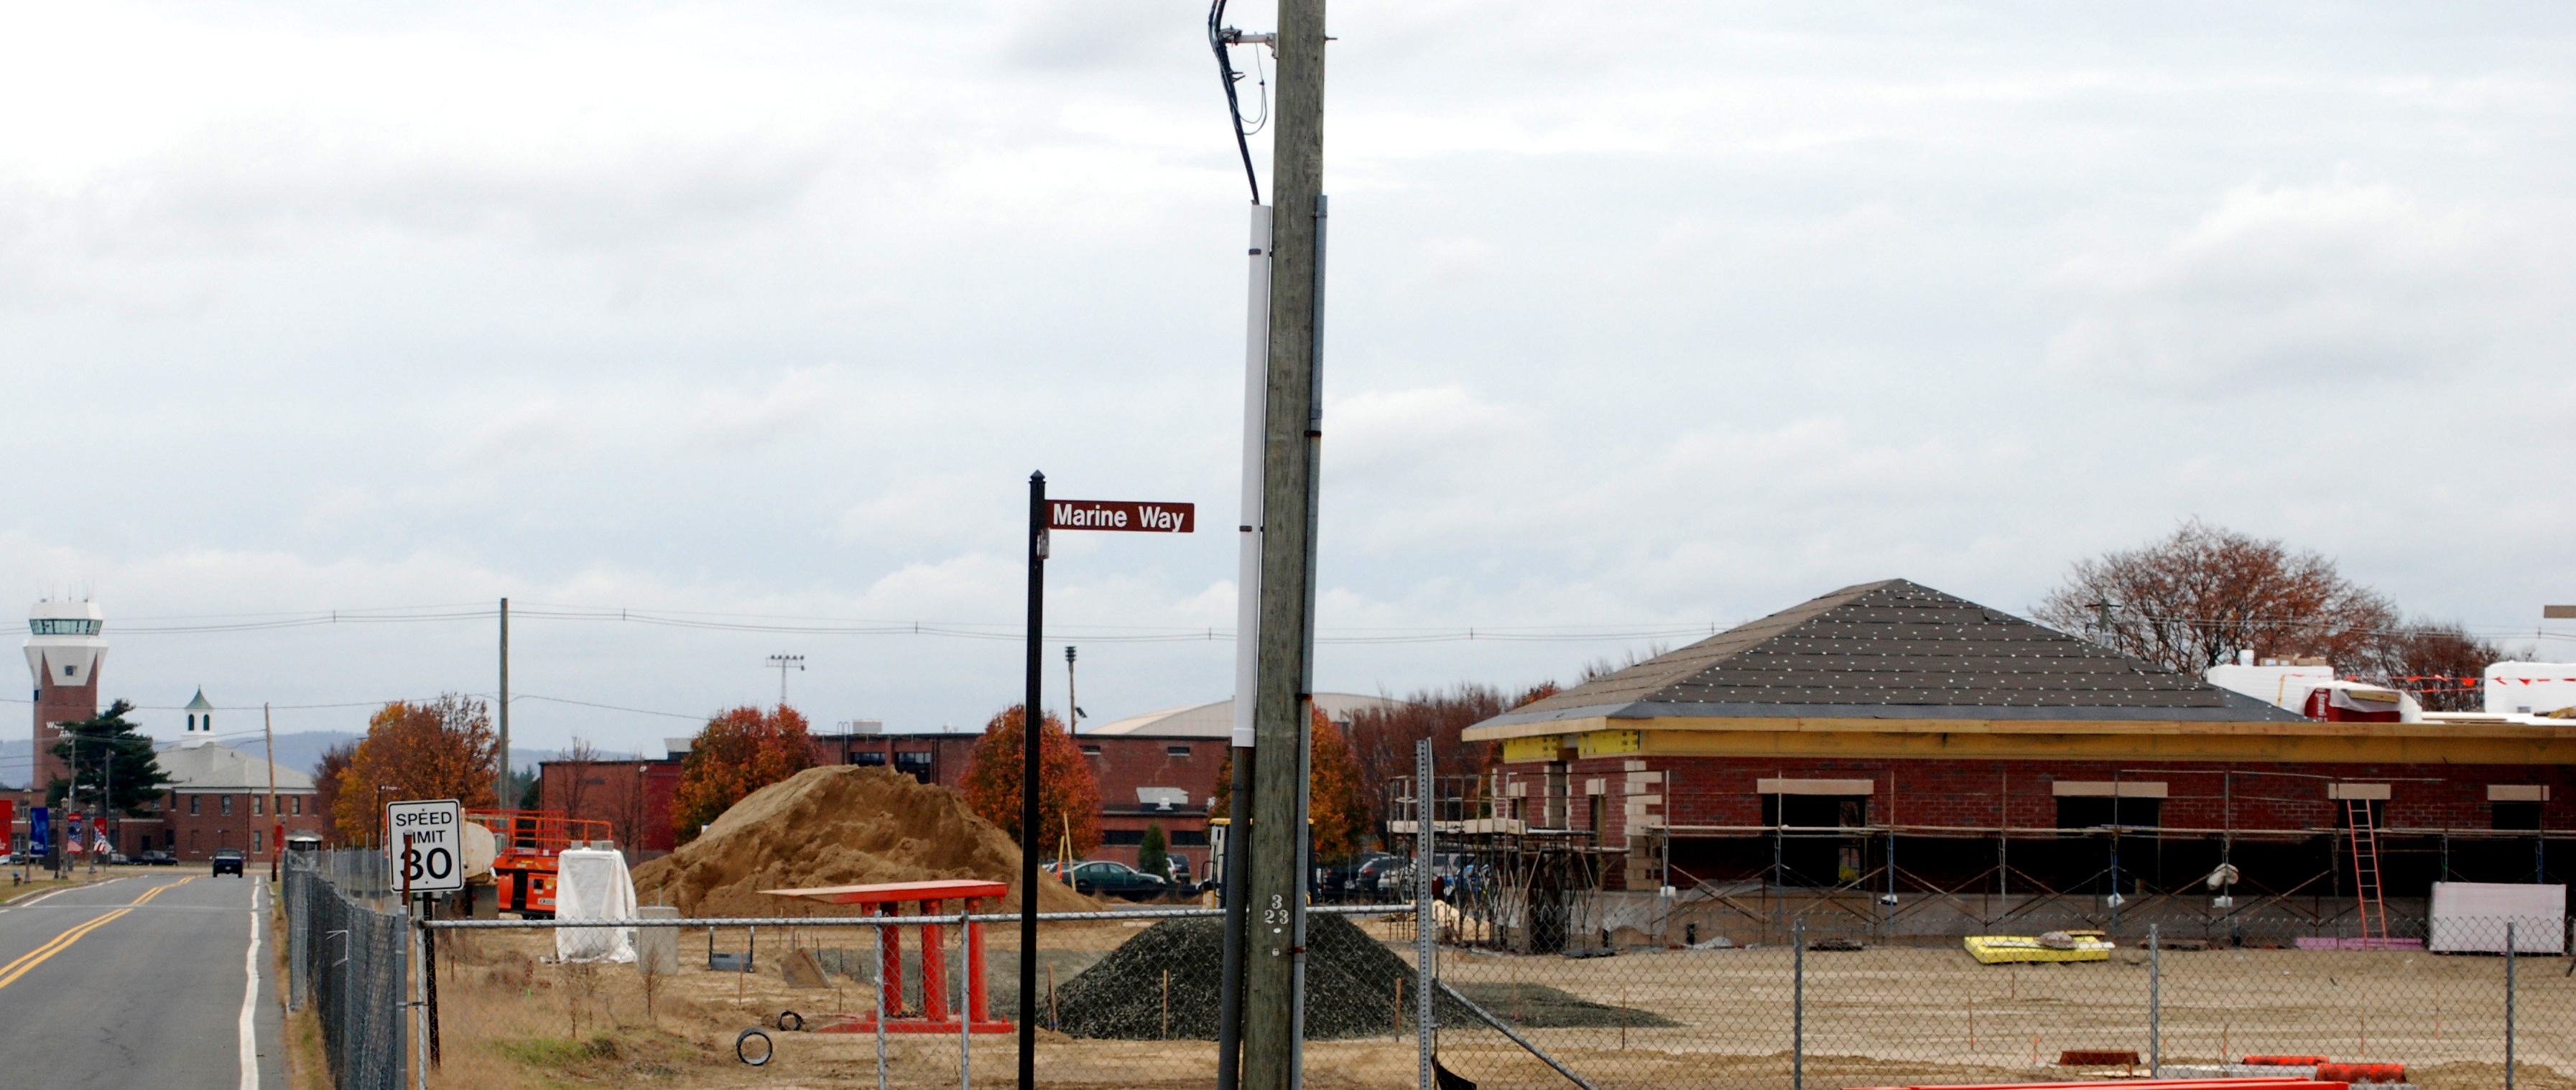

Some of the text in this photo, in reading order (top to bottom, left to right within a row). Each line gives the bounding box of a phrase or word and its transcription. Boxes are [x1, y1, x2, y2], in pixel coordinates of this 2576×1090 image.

[1053, 503, 1184, 533] Marine Way
[396, 811, 452, 826] SPEED
[400, 847, 453, 881] 30
[1272, 895, 1282, 909] 3
